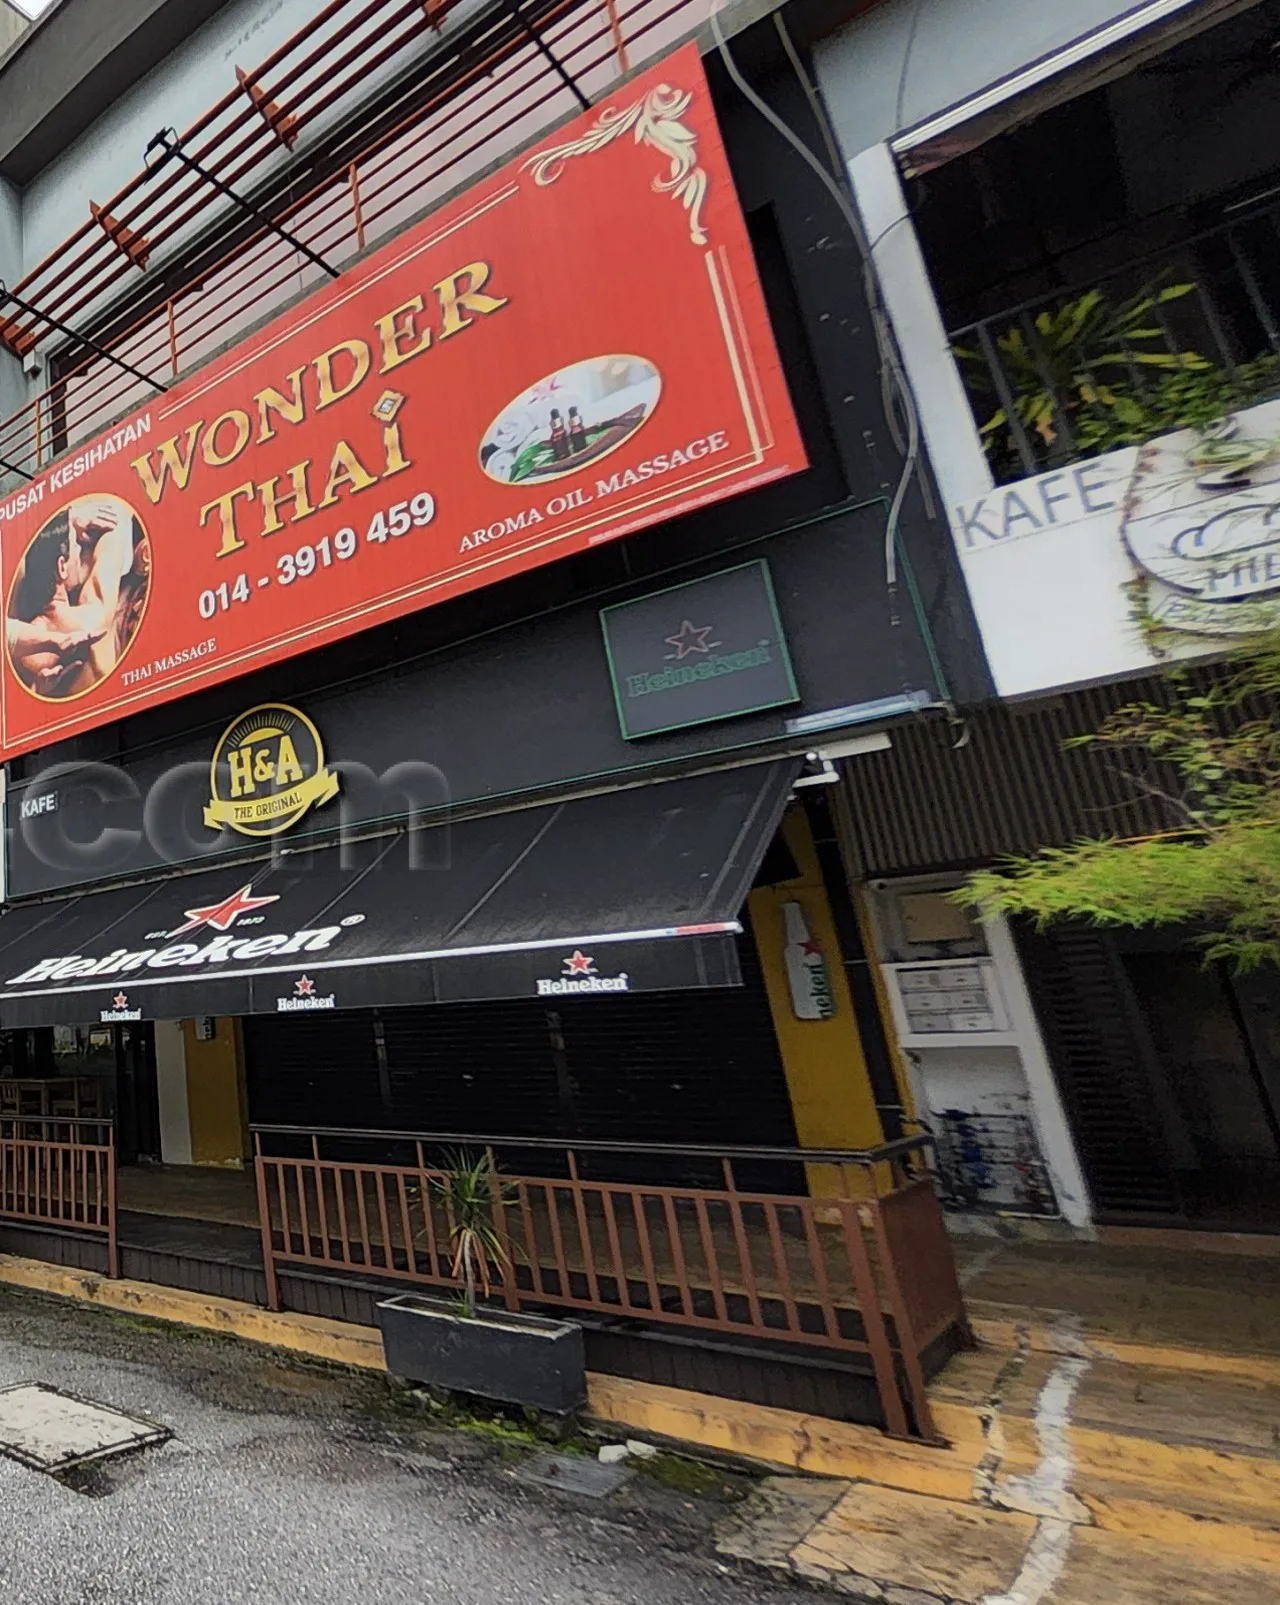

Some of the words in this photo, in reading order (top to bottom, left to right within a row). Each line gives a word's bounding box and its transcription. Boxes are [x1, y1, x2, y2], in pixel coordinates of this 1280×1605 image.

[130, 261, 508, 504] WONDER
[50, 413, 151, 493] KESIHATAN
[459, 507, 544, 553] AROMA
[546, 488, 594, 516] OIL
[596, 430, 730, 499] MASSAGE
[955, 461, 1118, 548] KAFE
[198, 573, 251, 619] 014
[276, 527, 357, 586] 3919
[366, 491, 436, 544] 459
[121, 663, 153, 687] THAI
[154, 637, 217, 674] MASSAGE
[625, 646, 772, 698] Heineken
[227, 734, 304, 798] H&A
[21, 793, 55, 819] KAFE
[233, 806, 253, 820] THE
[255, 792, 303, 817] ORIGINAL
[277, 993, 336, 1012] Heineken
[537, 973, 629, 996] Heineken
[101, 1008, 142, 1022] Heineken
